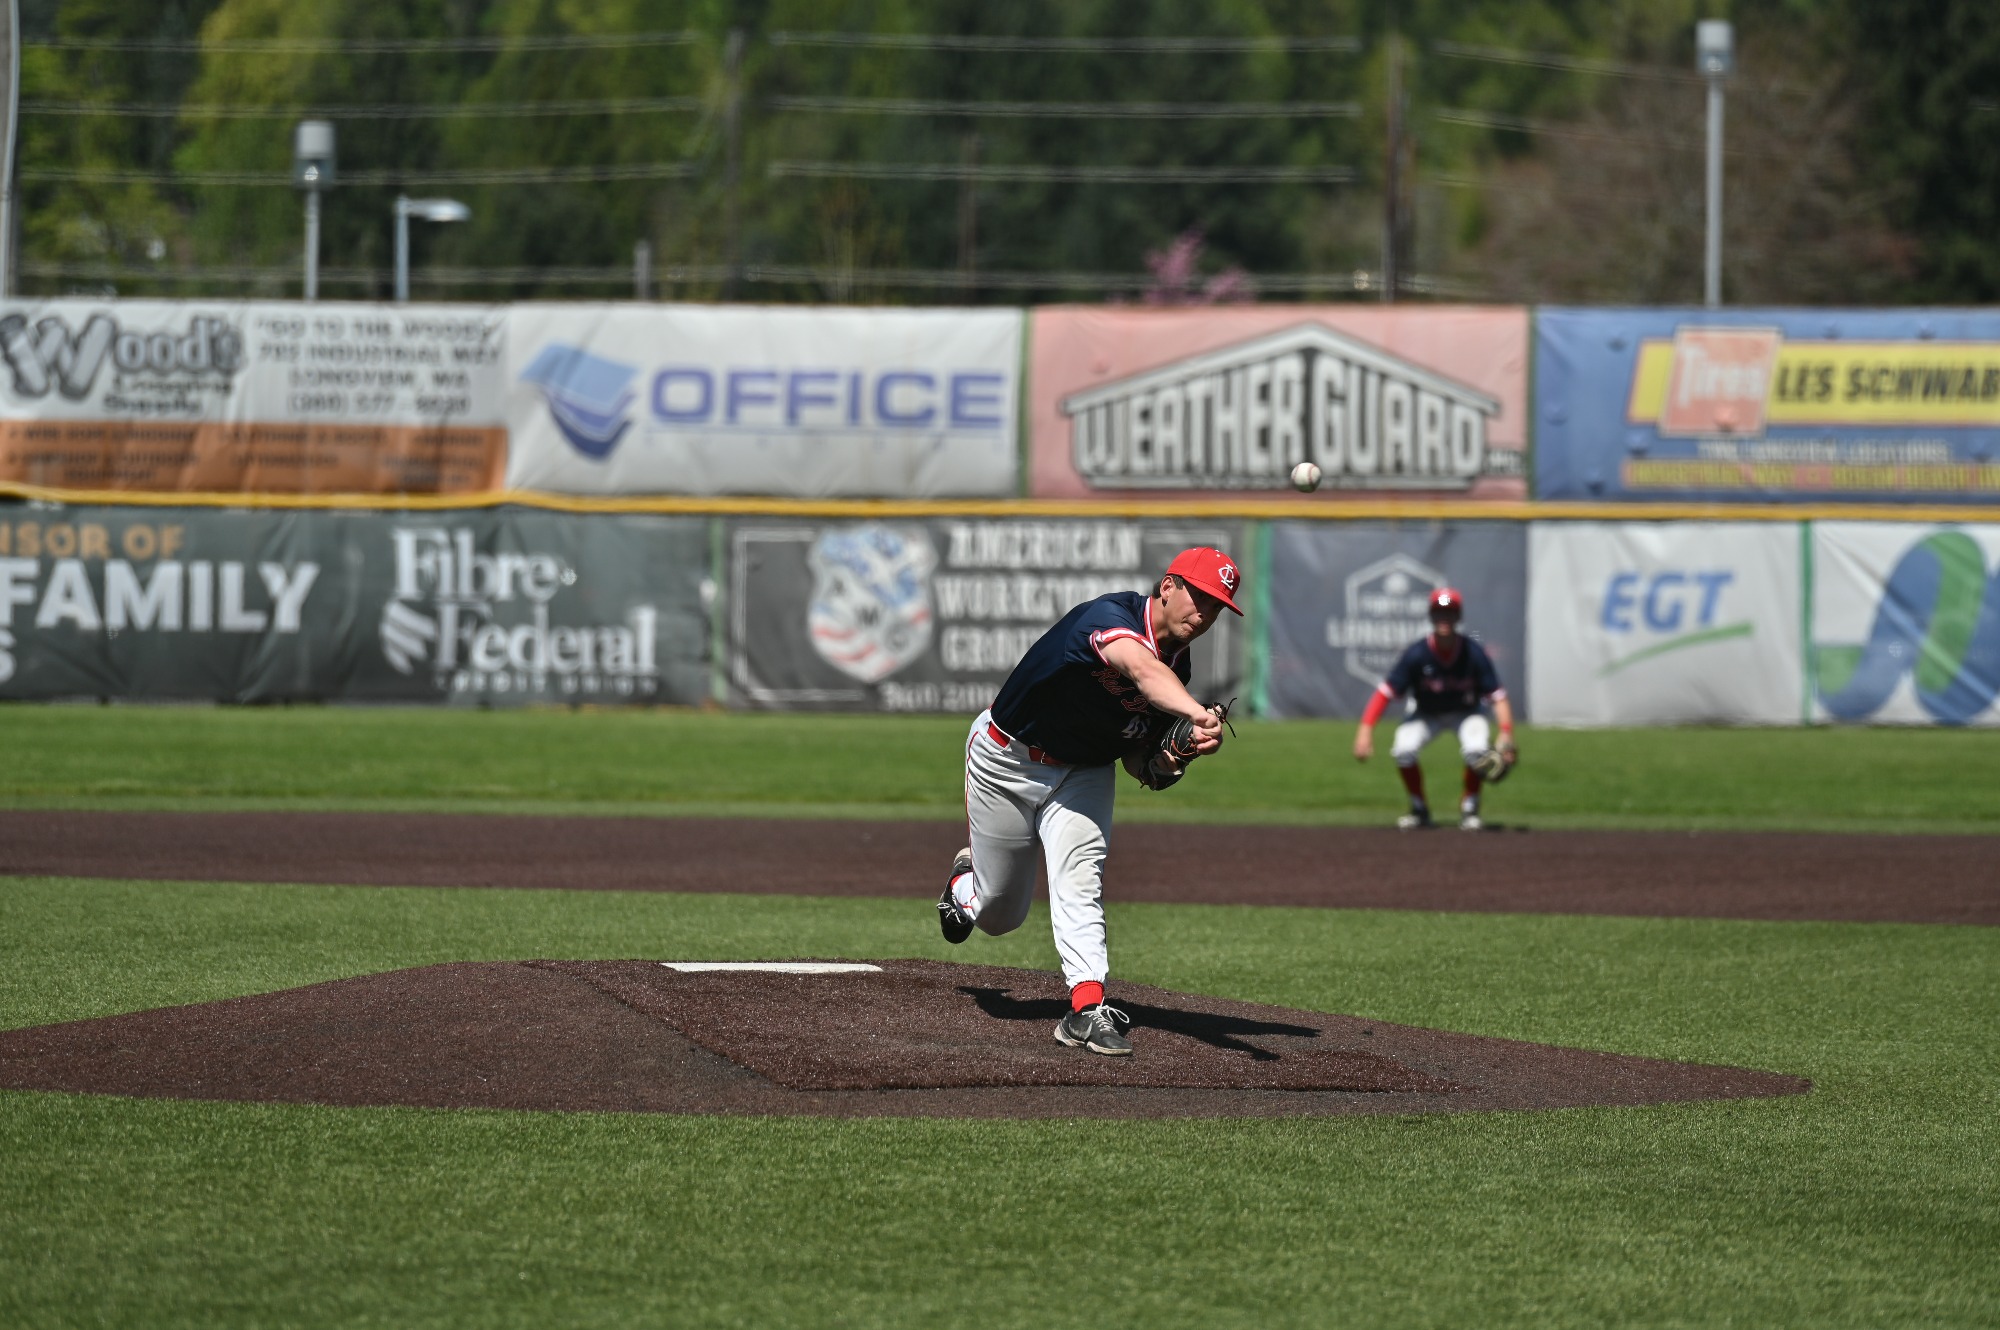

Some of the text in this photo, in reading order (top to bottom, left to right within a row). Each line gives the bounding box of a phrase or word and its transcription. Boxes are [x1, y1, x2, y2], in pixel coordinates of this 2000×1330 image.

[651, 369, 1005, 429] OFFICE
[1676, 343, 1766, 407] Tires
[1776, 364, 1836, 399] LES
[1070, 352, 1485, 478] WEATHER GUARD
[122, 524, 185, 559] OF
[391, 528, 560, 601] Fibre
[948, 524, 1141, 570] AMERICAN
[0, 557, 320, 633] FAMILY
[1602, 571, 1733, 632] EGT
[432, 600, 659, 676] Federal
[1091, 668, 1135, 696] Red
